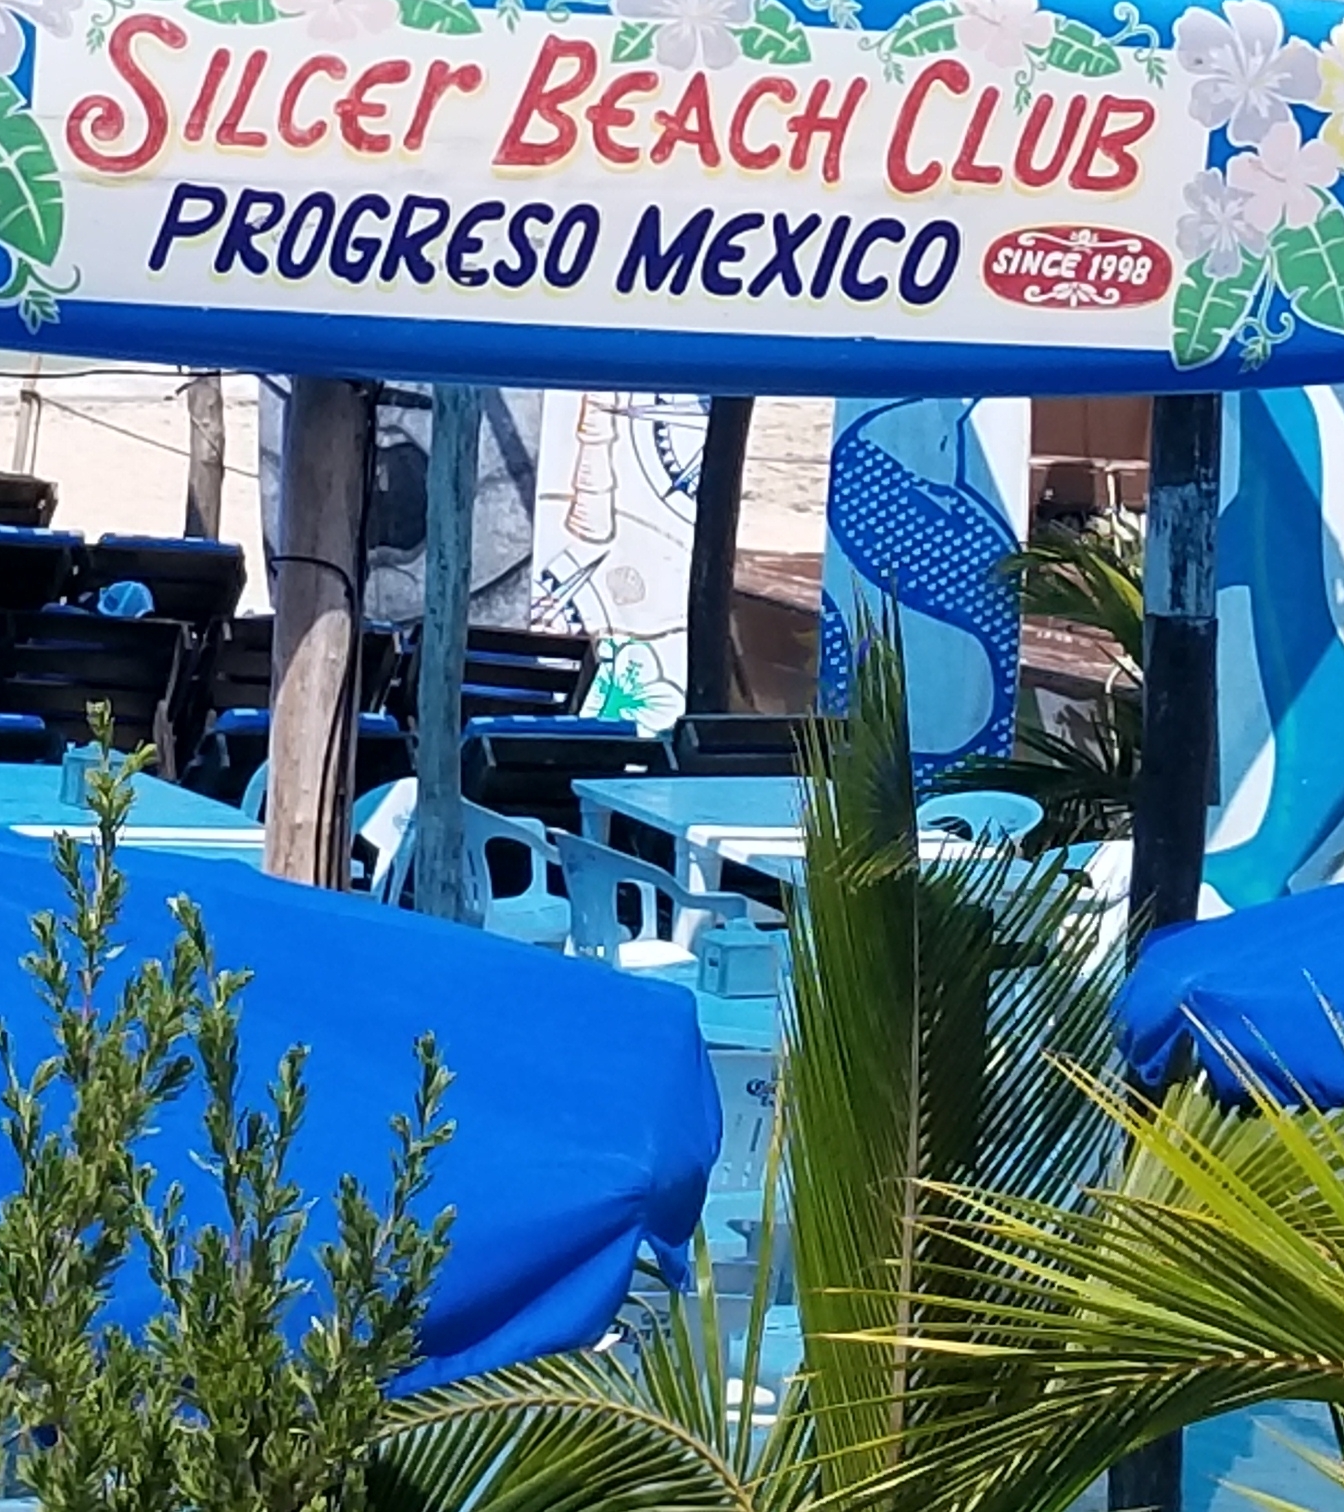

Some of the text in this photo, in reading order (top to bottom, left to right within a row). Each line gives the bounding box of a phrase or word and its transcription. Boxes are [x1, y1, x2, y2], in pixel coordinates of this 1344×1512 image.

[493, 35, 866, 184] BEACH
[887, 59, 1155, 194] CLUB
[149, 183, 960, 305] PROGRESO MEXICO
[992, 248, 1152, 285] SINCE 1998
